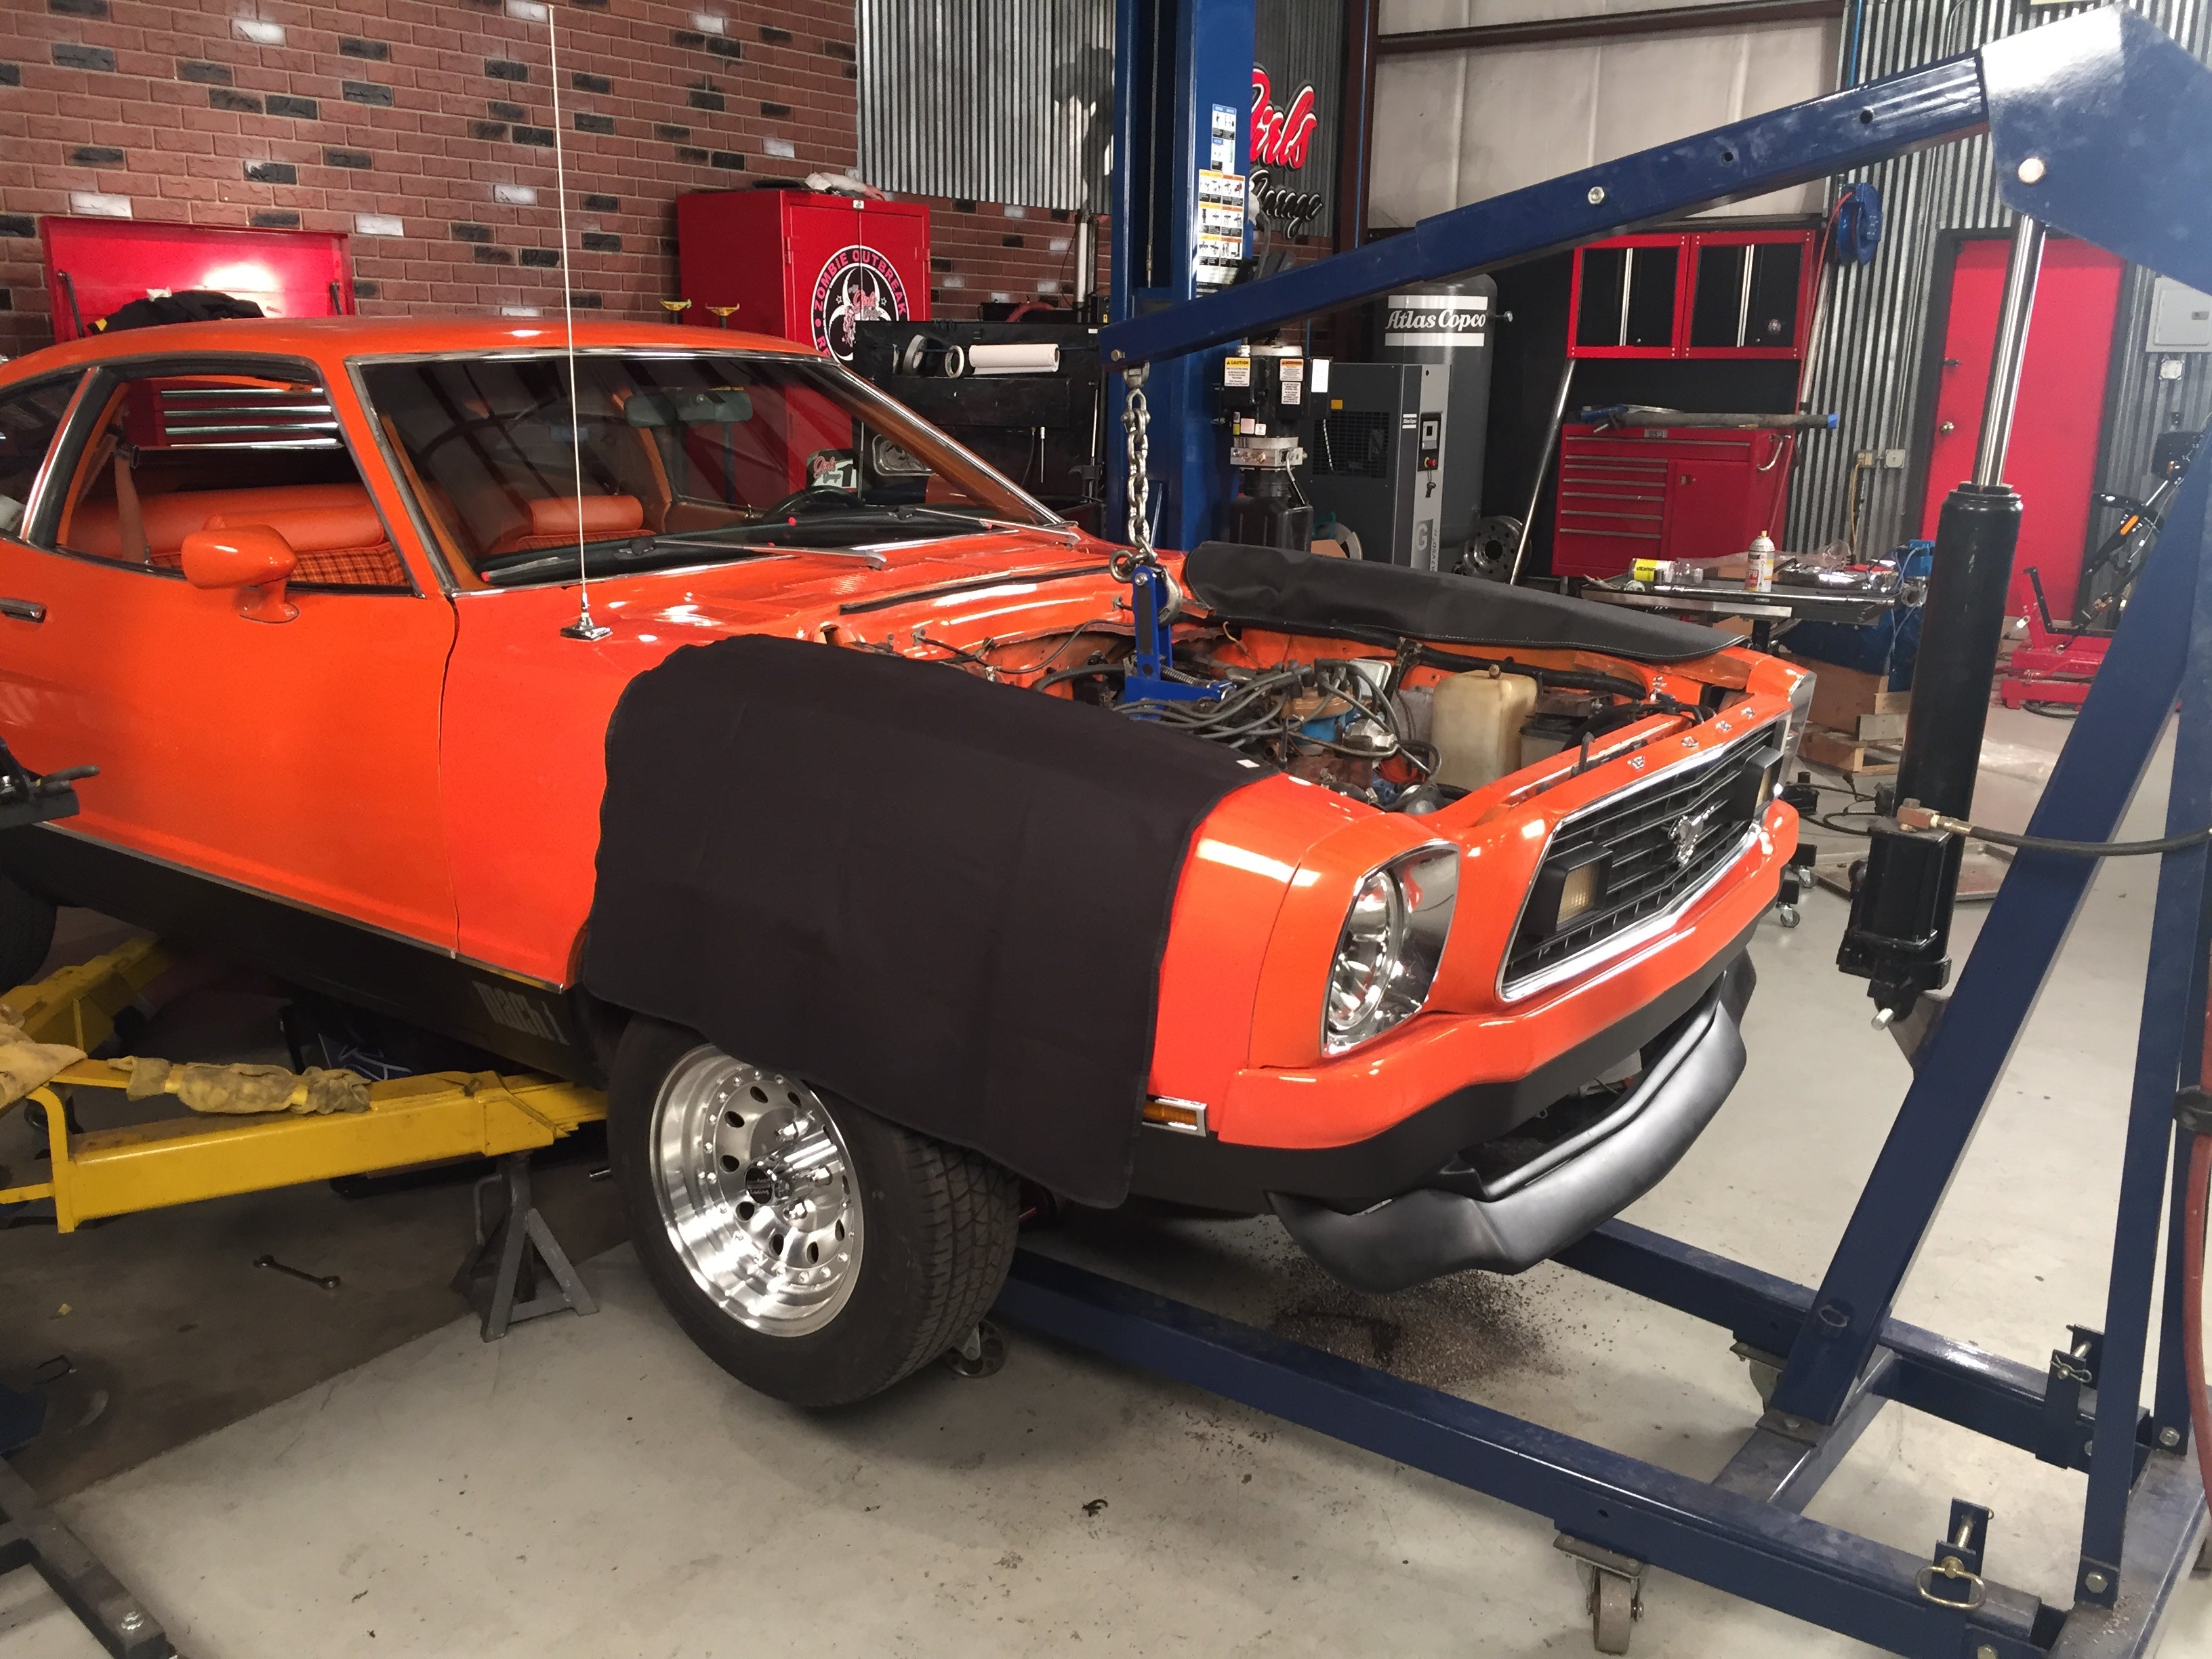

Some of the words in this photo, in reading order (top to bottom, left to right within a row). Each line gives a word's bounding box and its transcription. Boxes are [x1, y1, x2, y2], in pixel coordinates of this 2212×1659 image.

[815, 252, 848, 312] ZOMBIE
[852, 249, 906, 316] OUTBREAK
[1385, 310, 1437, 329] Atlas
[1438, 309, 1486, 331] Copco
